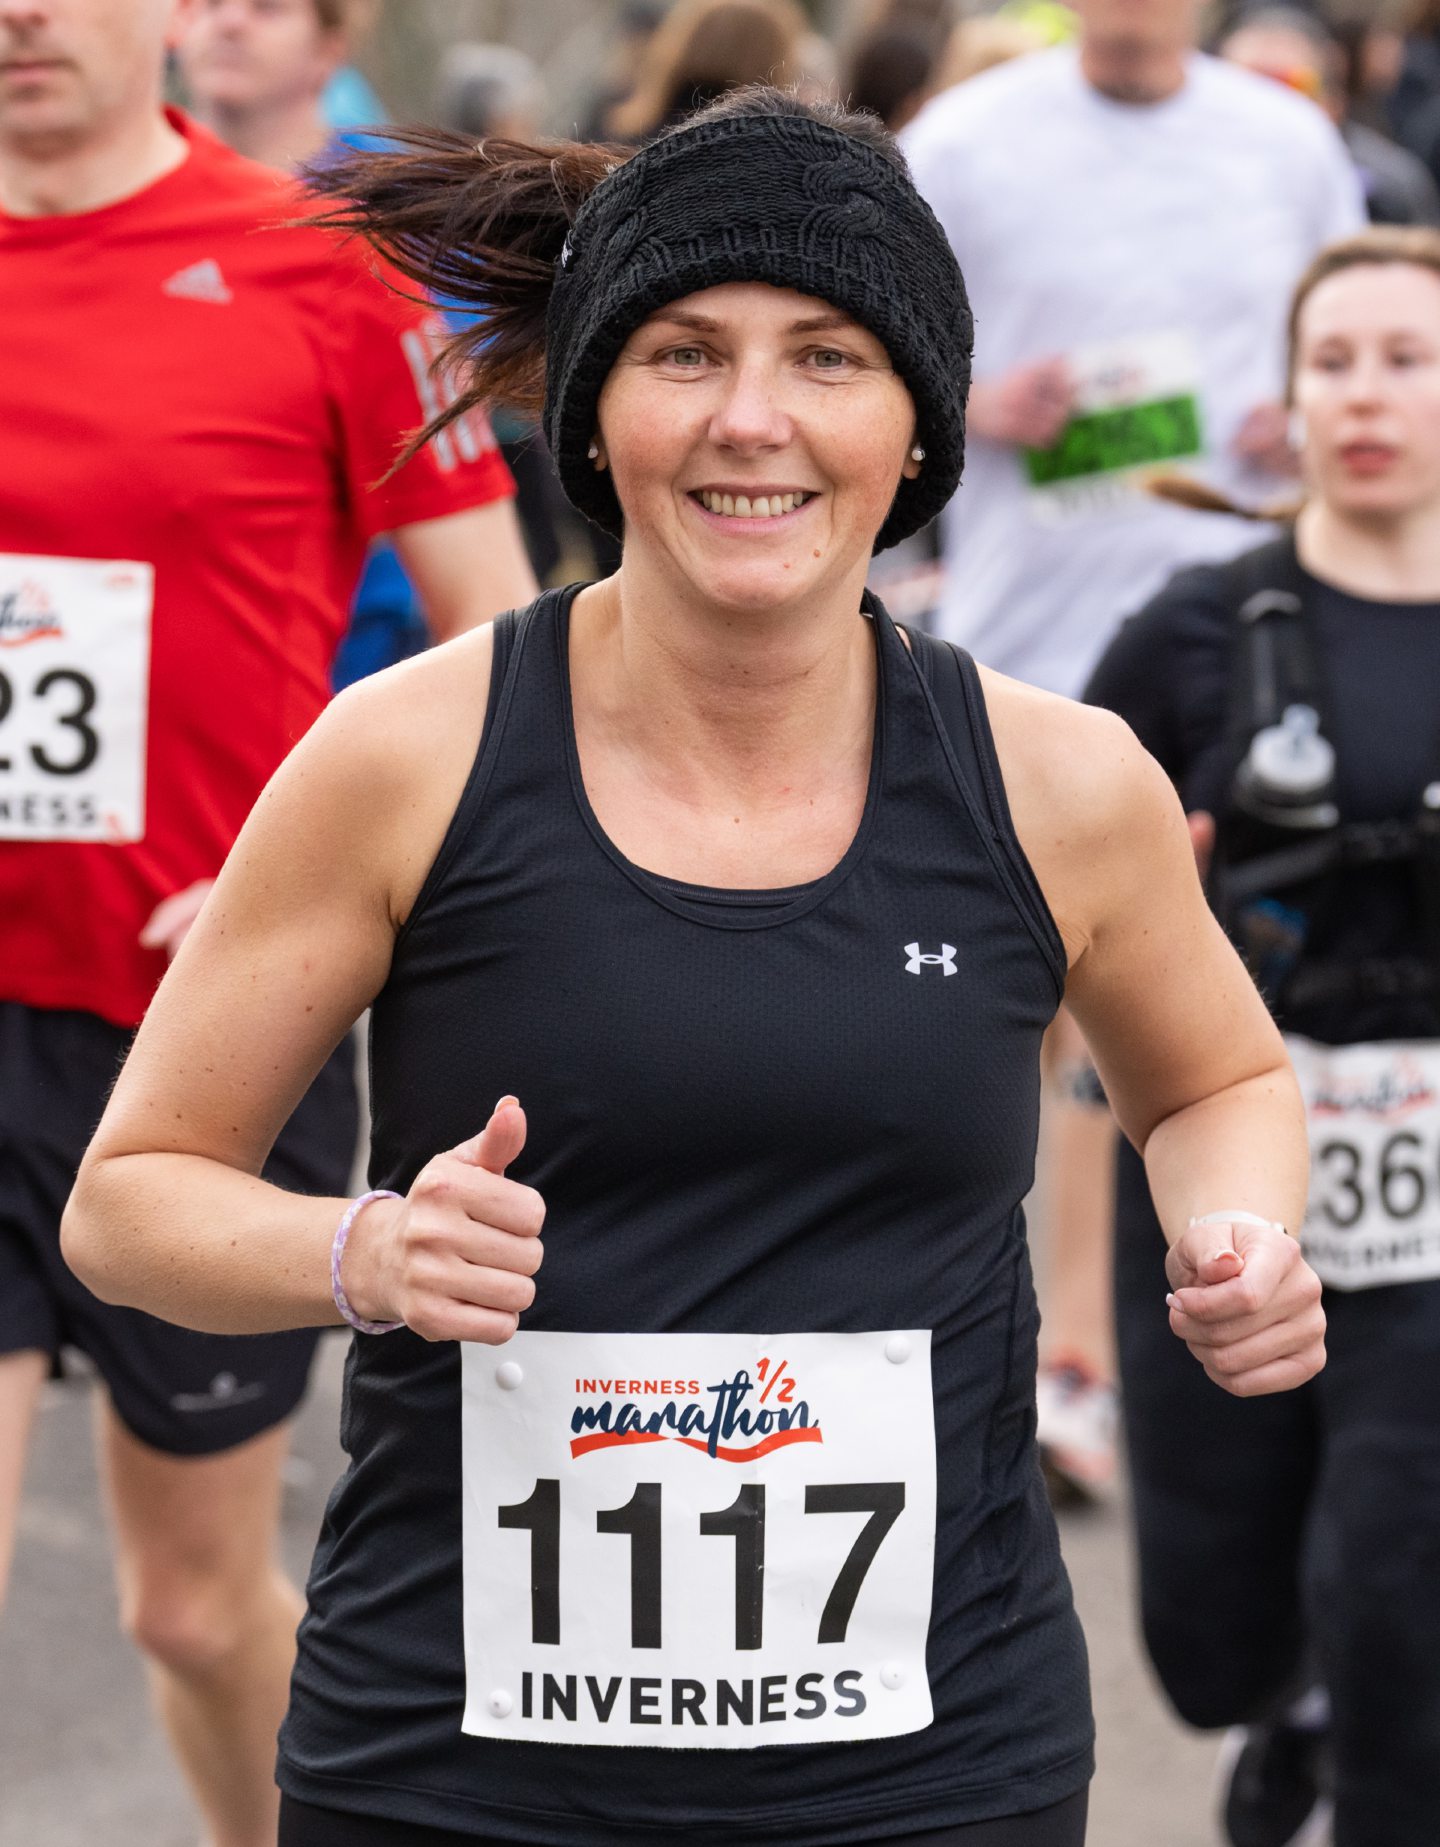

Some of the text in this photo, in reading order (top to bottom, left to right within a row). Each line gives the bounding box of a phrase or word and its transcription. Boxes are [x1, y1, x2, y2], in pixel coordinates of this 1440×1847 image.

[0, 668, 101, 777] 3
[1319, 1131, 1440, 1231] 36
[571, 1370, 820, 1459] marathon
[575, 1378, 700, 1395] INVERNESS
[498, 1478, 906, 1651] 1117
[521, 1670, 867, 1726] INVERNESS
